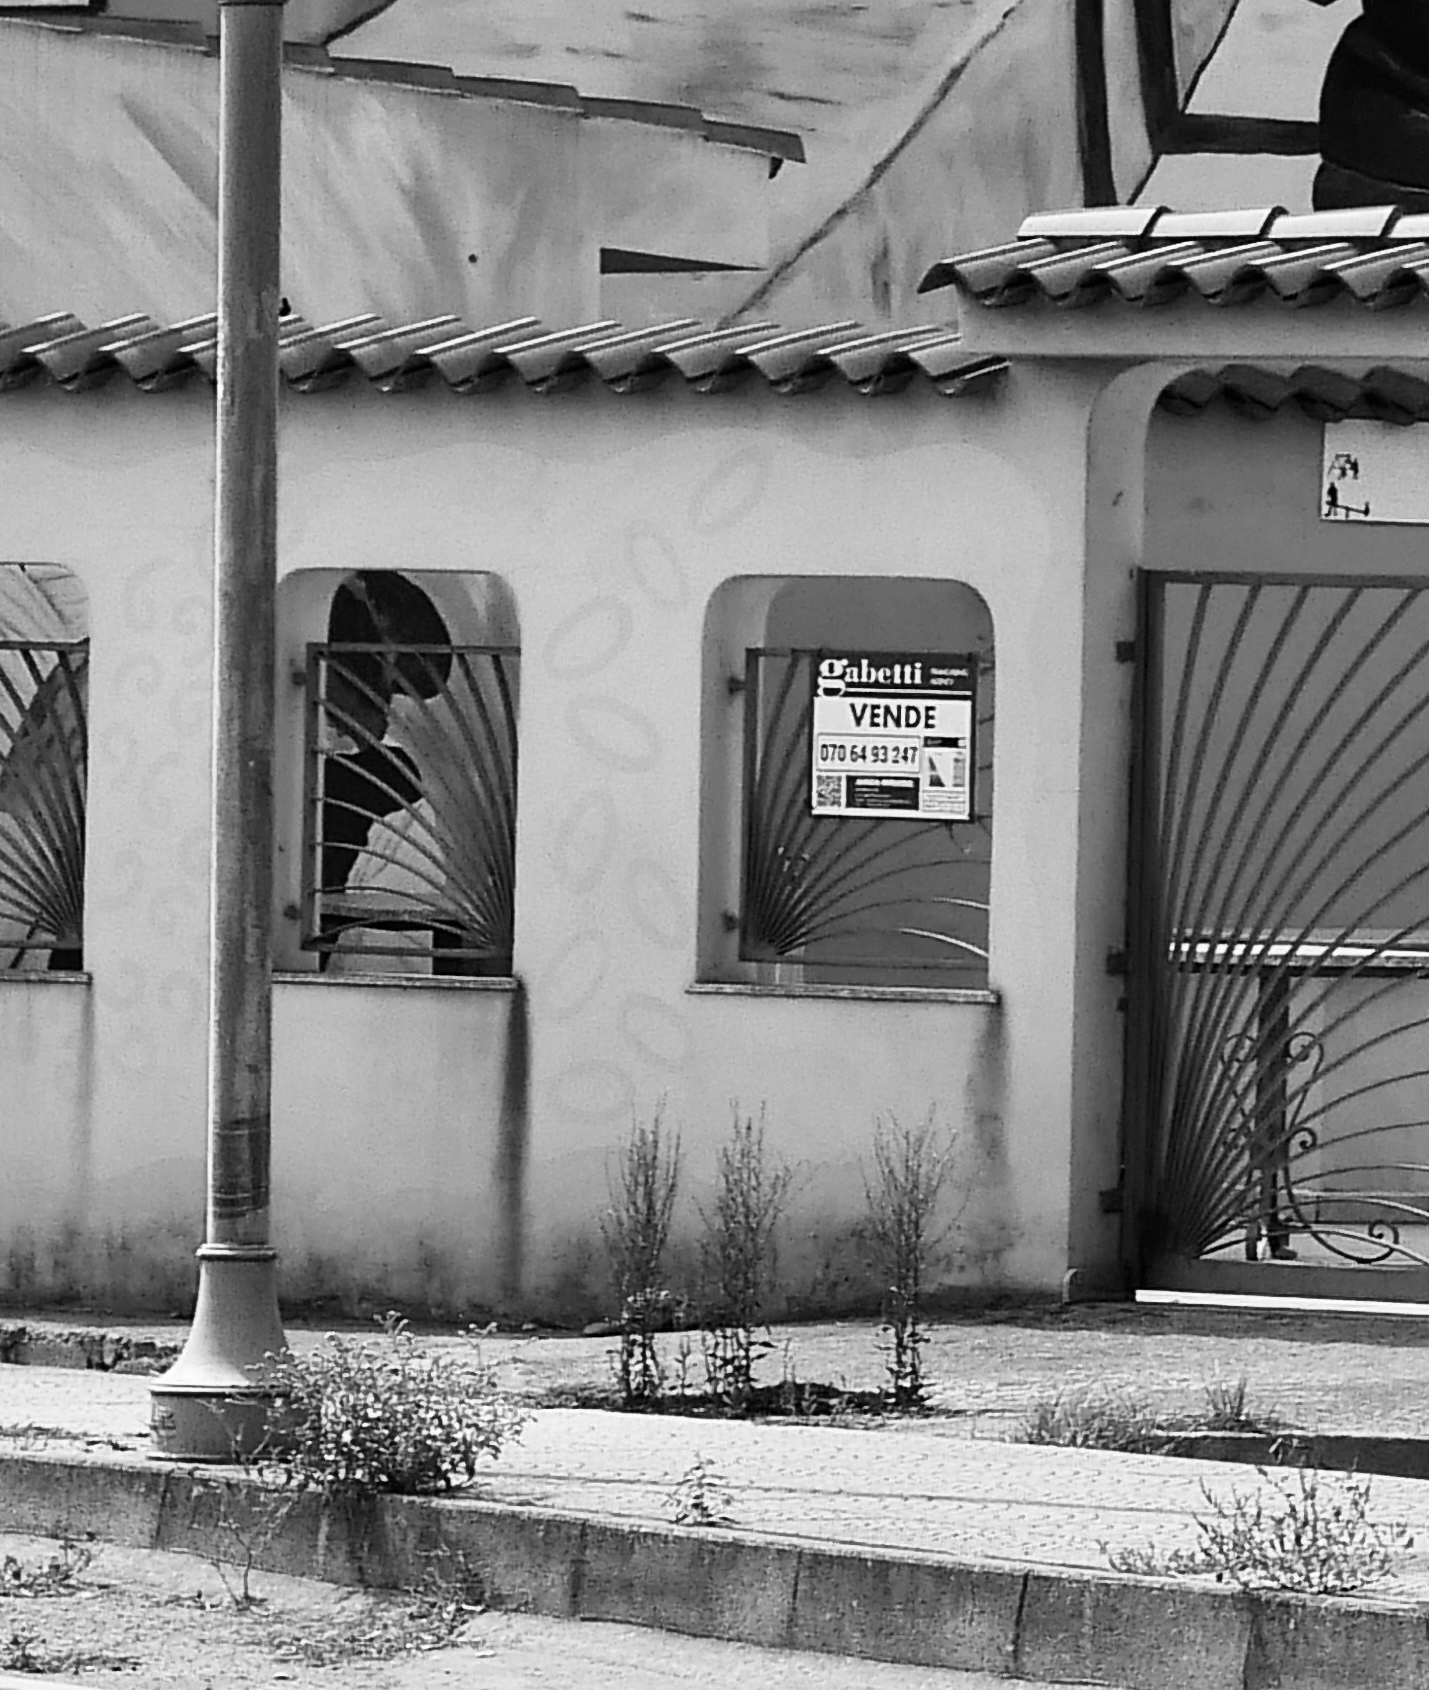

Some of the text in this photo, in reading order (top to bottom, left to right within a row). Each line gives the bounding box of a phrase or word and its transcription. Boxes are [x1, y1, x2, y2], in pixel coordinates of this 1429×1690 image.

[816, 658, 922, 697] gabetti
[849, 702, 937, 729] VENDE
[820, 743, 847, 762] 070
[850, 744, 868, 763] 64
[871, 745, 888, 763] 93
